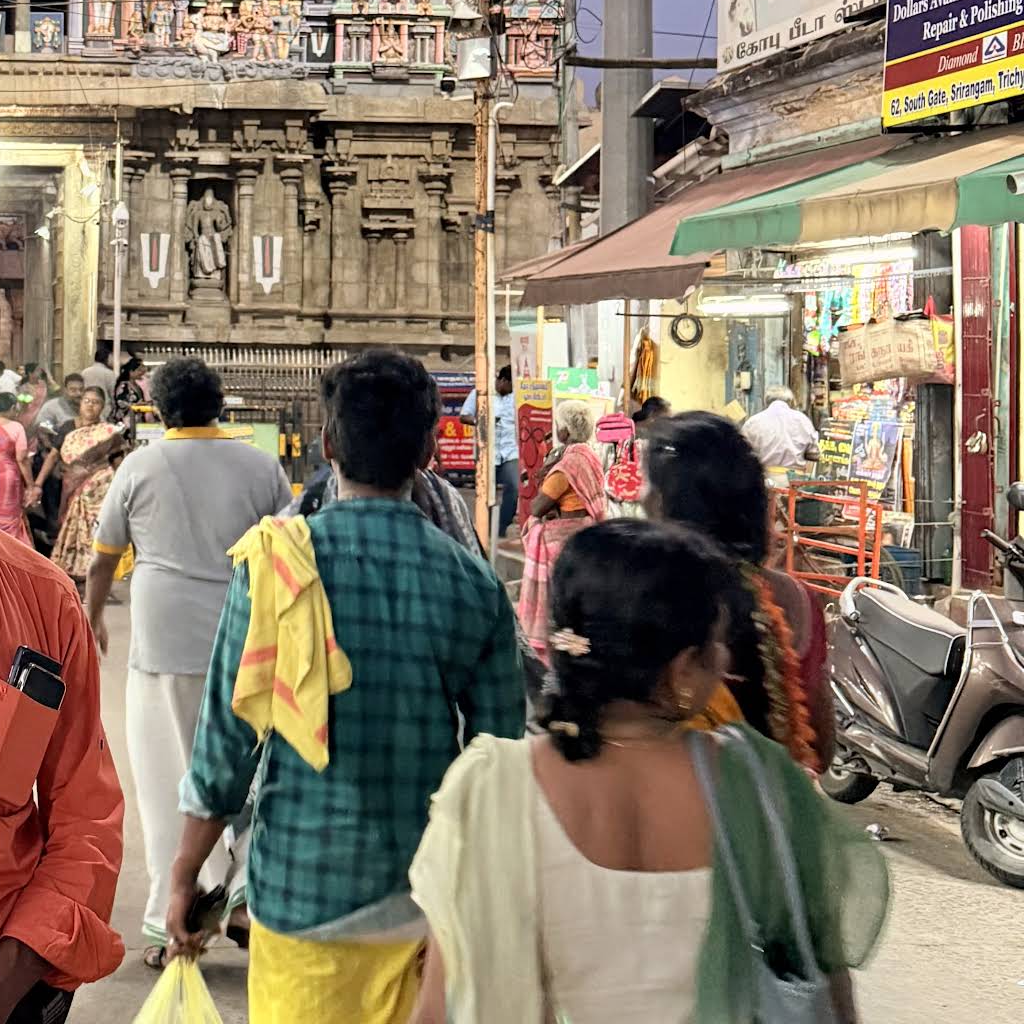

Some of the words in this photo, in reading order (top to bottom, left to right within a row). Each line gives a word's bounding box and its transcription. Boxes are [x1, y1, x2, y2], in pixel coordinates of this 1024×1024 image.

[736, 33, 780, 59] கோபு
[789, 17, 826, 40] பீடா
[923, 12, 958, 41] Repair
[959, 8, 969, 29] &
[938, 46, 979, 73] Diamond
[891, 98, 902, 117] 62,
[904, 93, 926, 113] South
[928, 89, 949, 108] Gate,
[951, 78, 995, 102] Srirangam,
